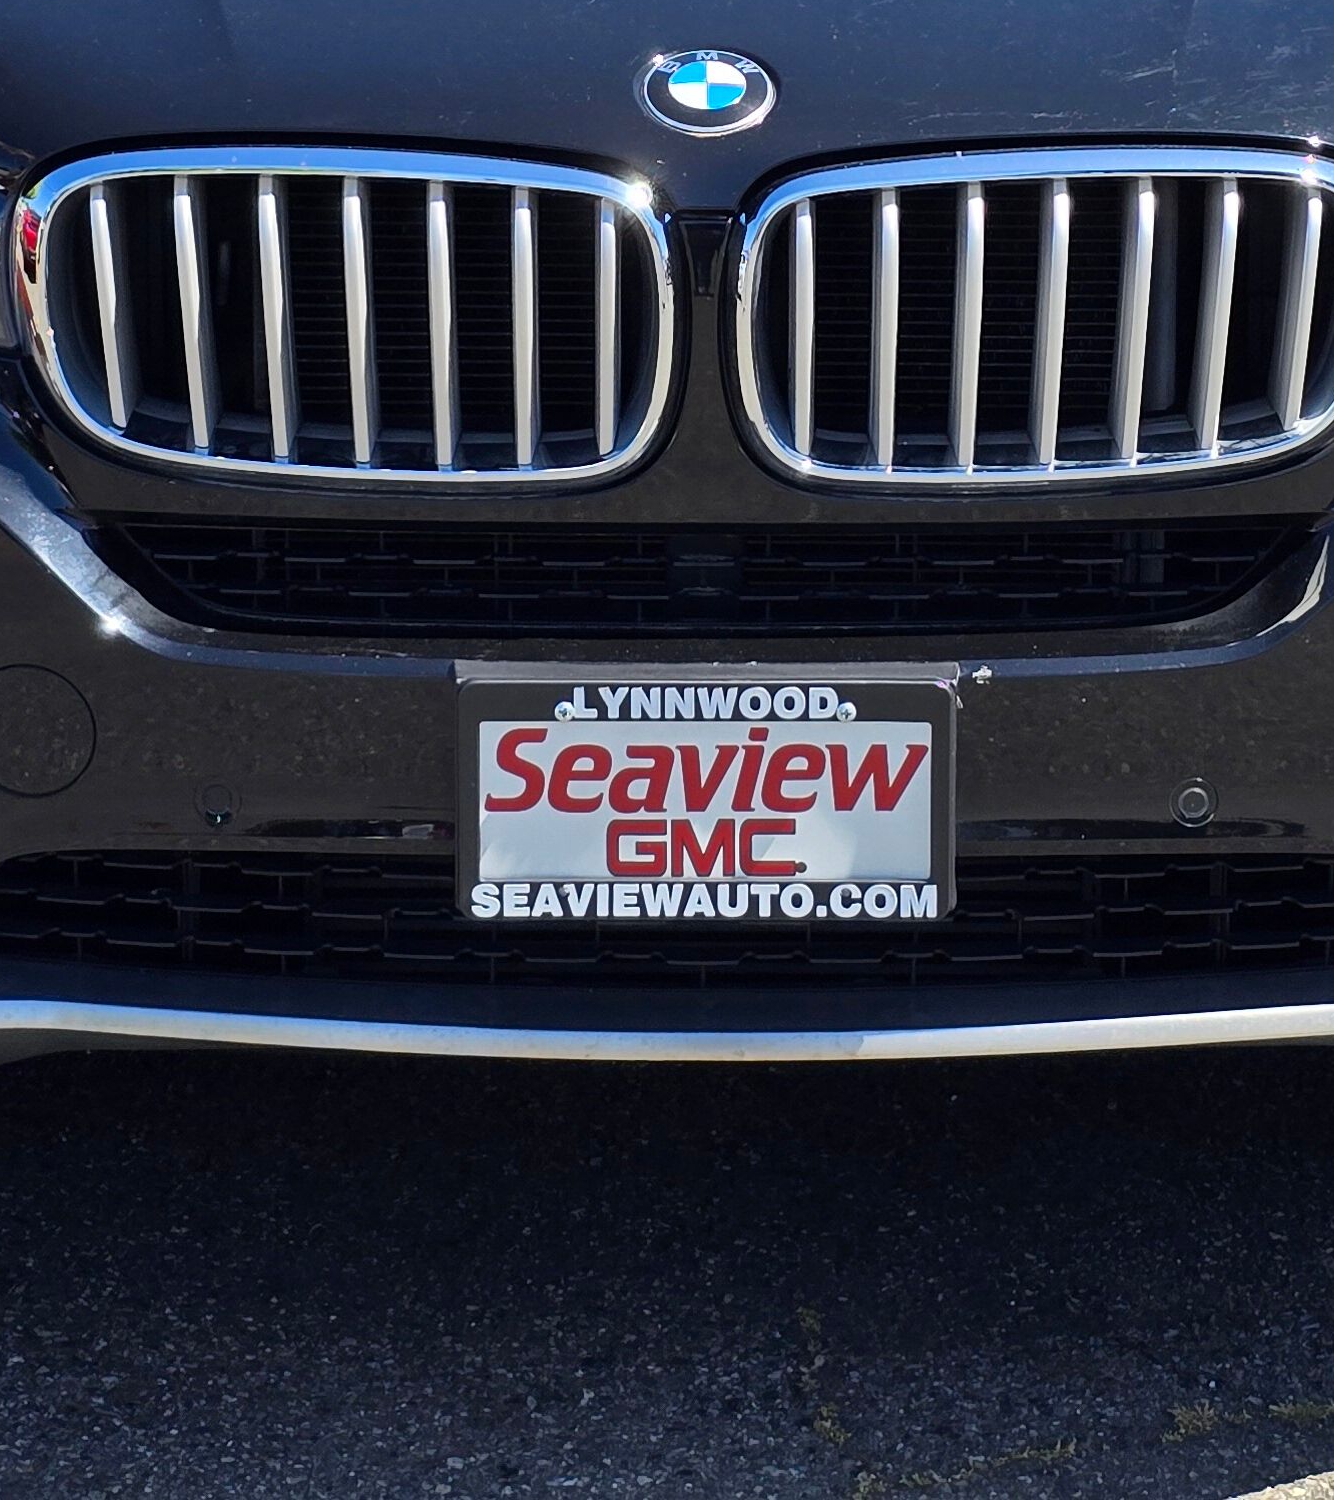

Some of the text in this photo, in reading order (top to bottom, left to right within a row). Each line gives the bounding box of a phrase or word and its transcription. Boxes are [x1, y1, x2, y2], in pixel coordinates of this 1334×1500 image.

[657, 52, 760, 74] BMW
[572, 685, 839, 720] LYNNWOOD
[483, 726, 930, 814] Seaview
[605, 817, 798, 879] GMC
[470, 882, 939, 919] SEAVIEWAUTO.COM
